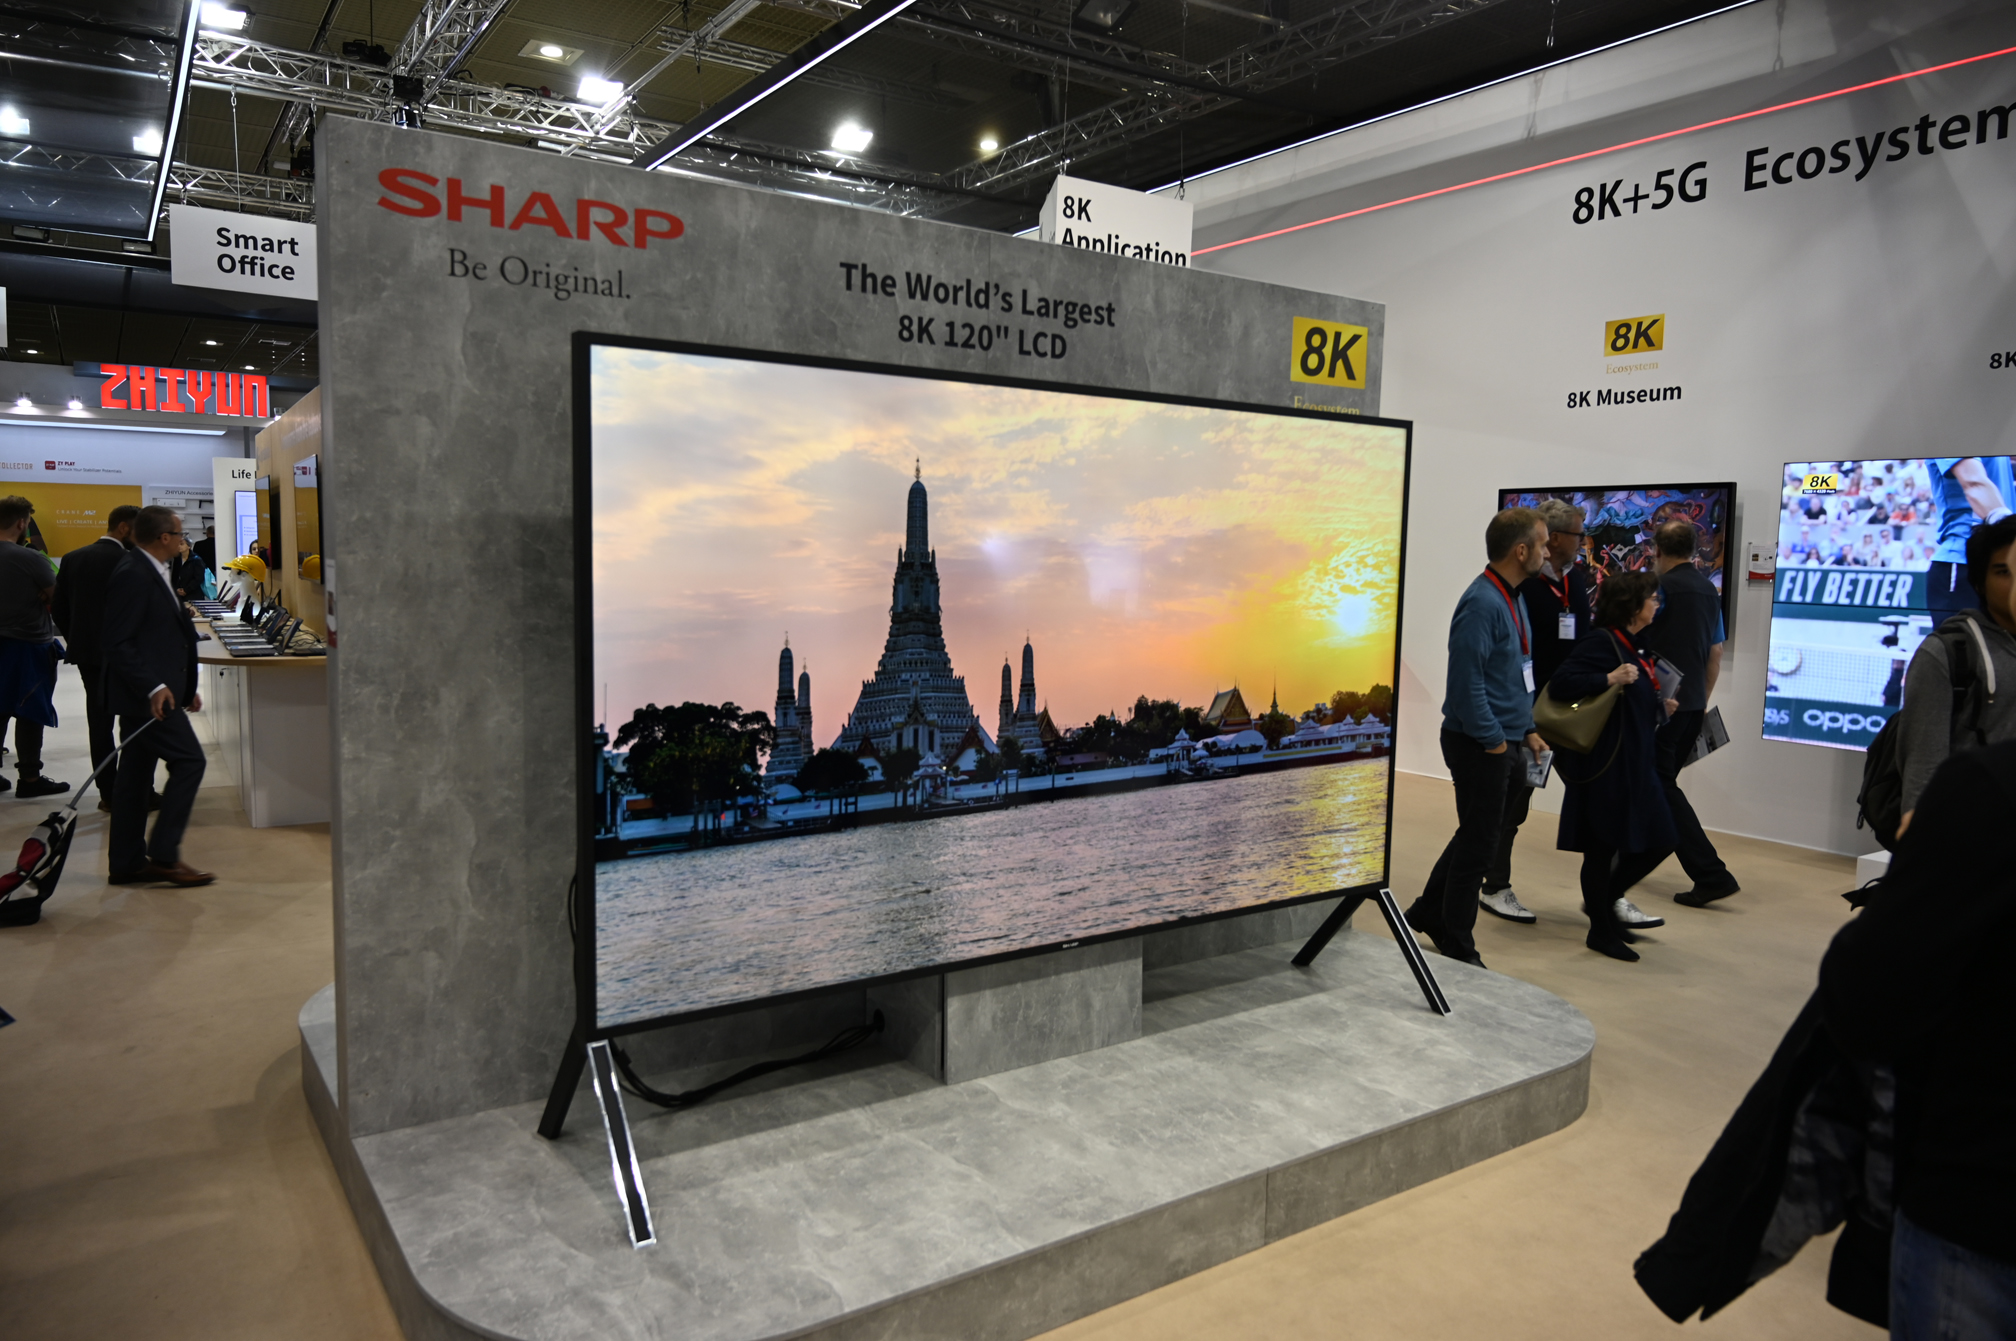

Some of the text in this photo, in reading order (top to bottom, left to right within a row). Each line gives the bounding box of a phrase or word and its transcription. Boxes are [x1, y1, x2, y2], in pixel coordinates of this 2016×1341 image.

[1572, 101, 2016, 225] 8K+5G Ecosystem
[377, 168, 685, 249] SHARP
[1062, 195, 1092, 223] 8K
[216, 227, 299, 256] Smart
[217, 253, 295, 281] Office
[447, 248, 631, 301] Be Original.
[838, 262, 897, 297] The
[1021, 289, 1116, 329] Largest
[898, 315, 1067, 359] 8K 120" LCD
[1611, 318, 1661, 352] 8K
[1300, 326, 1363, 381] 8K
[1605, 361, 1659, 375] Ecosystem
[1989, 351, 2016, 369] 8K
[100, 363, 267, 418] ZHIYUN
[1567, 385, 1682, 409] 8K Museum
[0, 462, 33, 470] OLLECTOR
[231, 469, 252, 479] Life
[1809, 475, 1832, 488] 8K
[1778, 570, 1913, 607] FLY BETTER
